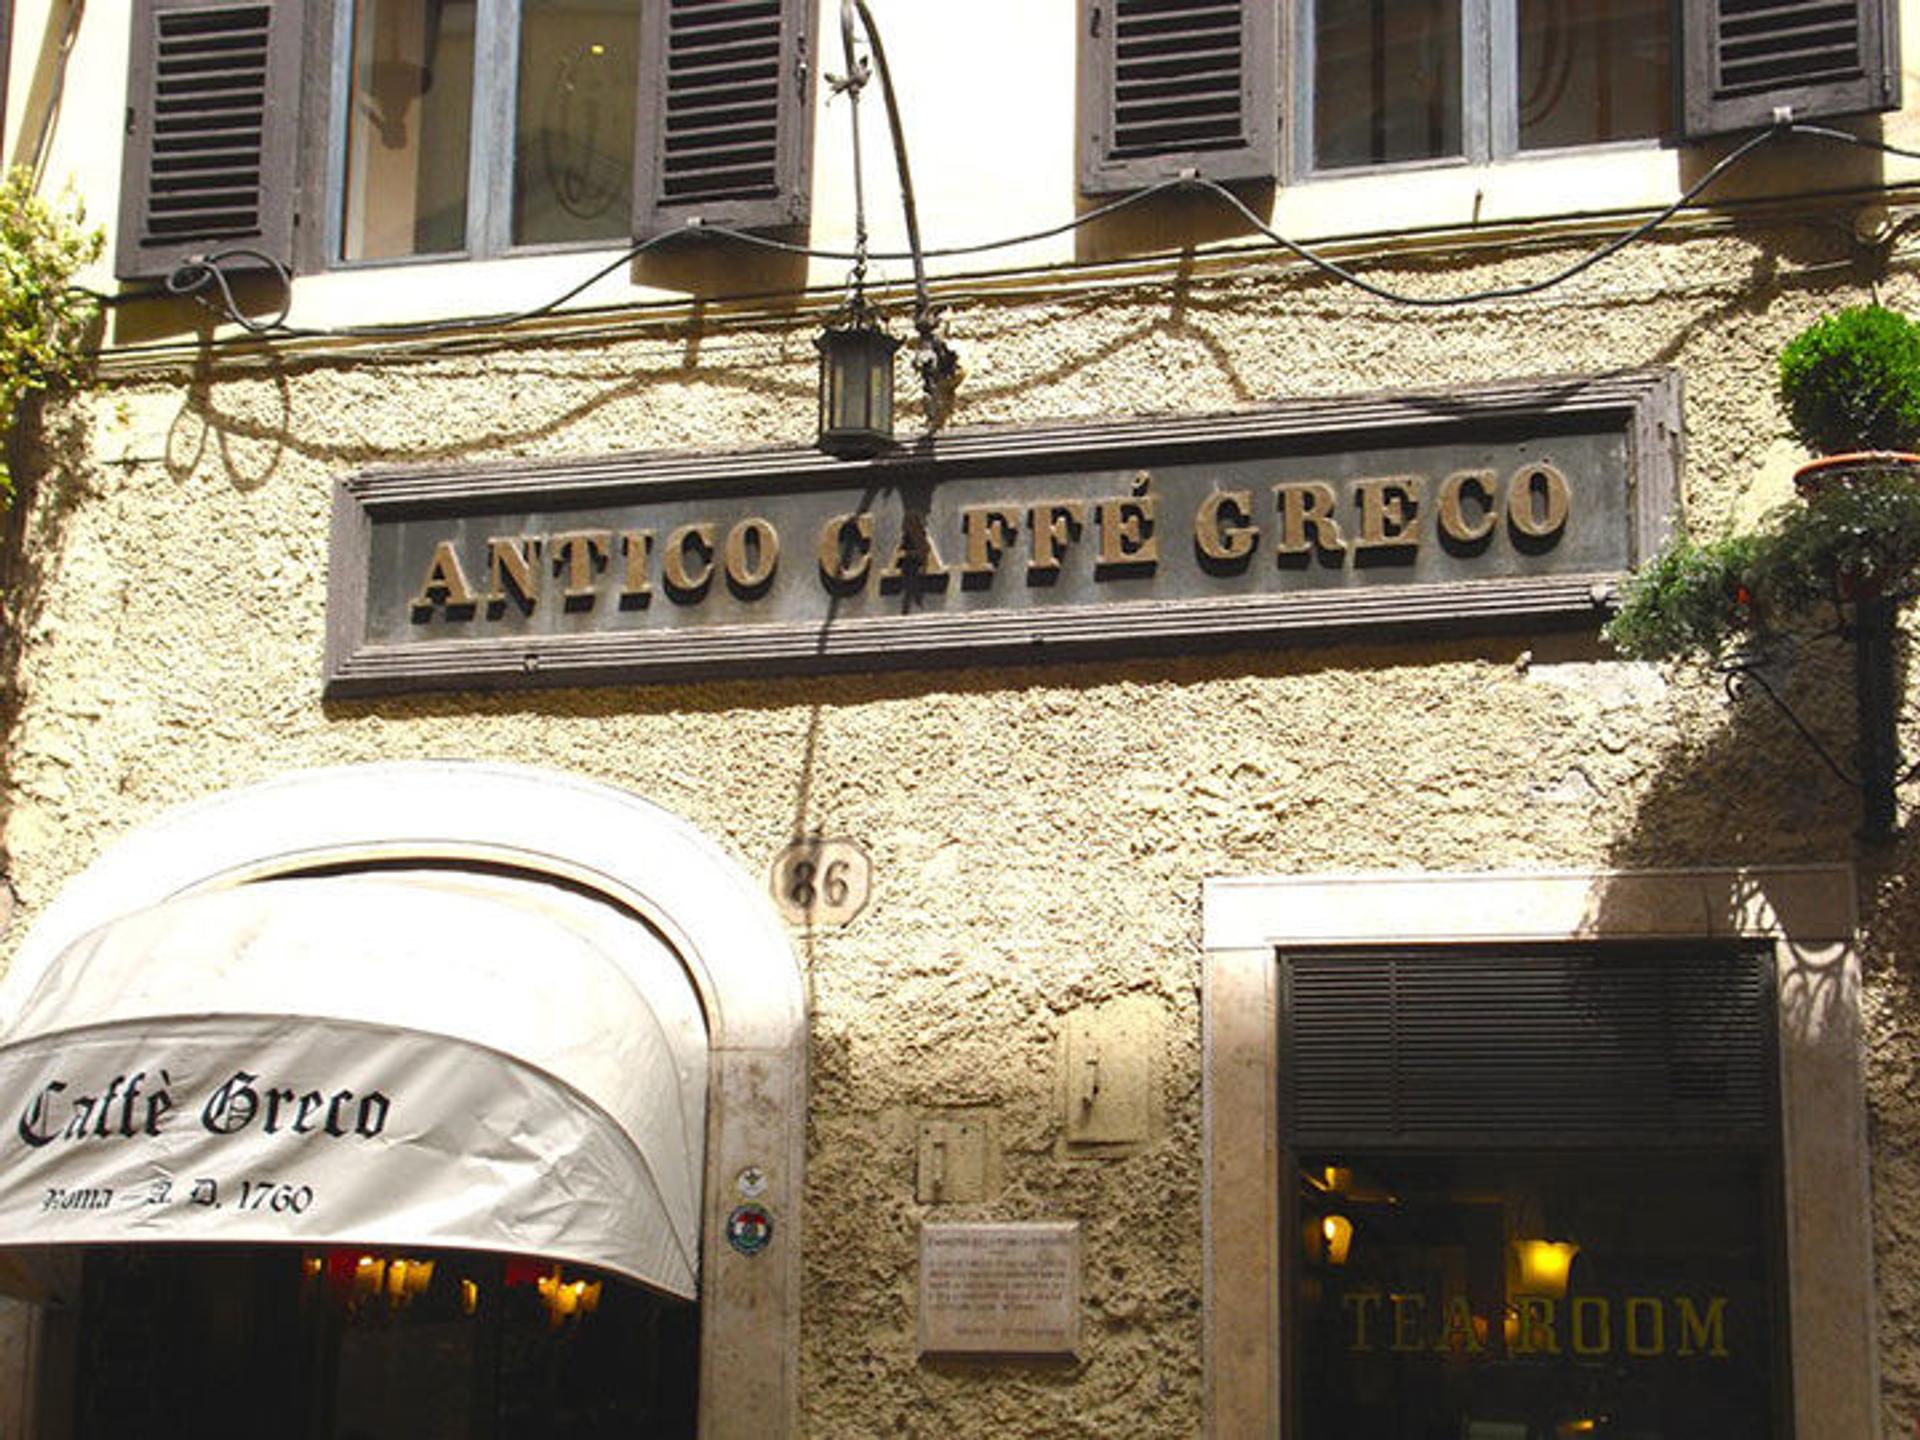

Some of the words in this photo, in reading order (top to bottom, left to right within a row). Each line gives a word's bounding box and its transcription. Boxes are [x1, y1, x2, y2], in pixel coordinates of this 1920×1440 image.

[411, 516, 781, 613] ANTICO
[818, 470, 1158, 588] CAFFÉ
[1194, 462, 1570, 568] GRECO
[791, 860, 849, 908] 86
[18, 1070, 173, 1147] Caffè
[202, 1071, 390, 1138] Greco
[238, 1181, 314, 1214] 1760
[1344, 1295, 1484, 1353] TEA
[1514, 1296, 1728, 1357] ROOM
